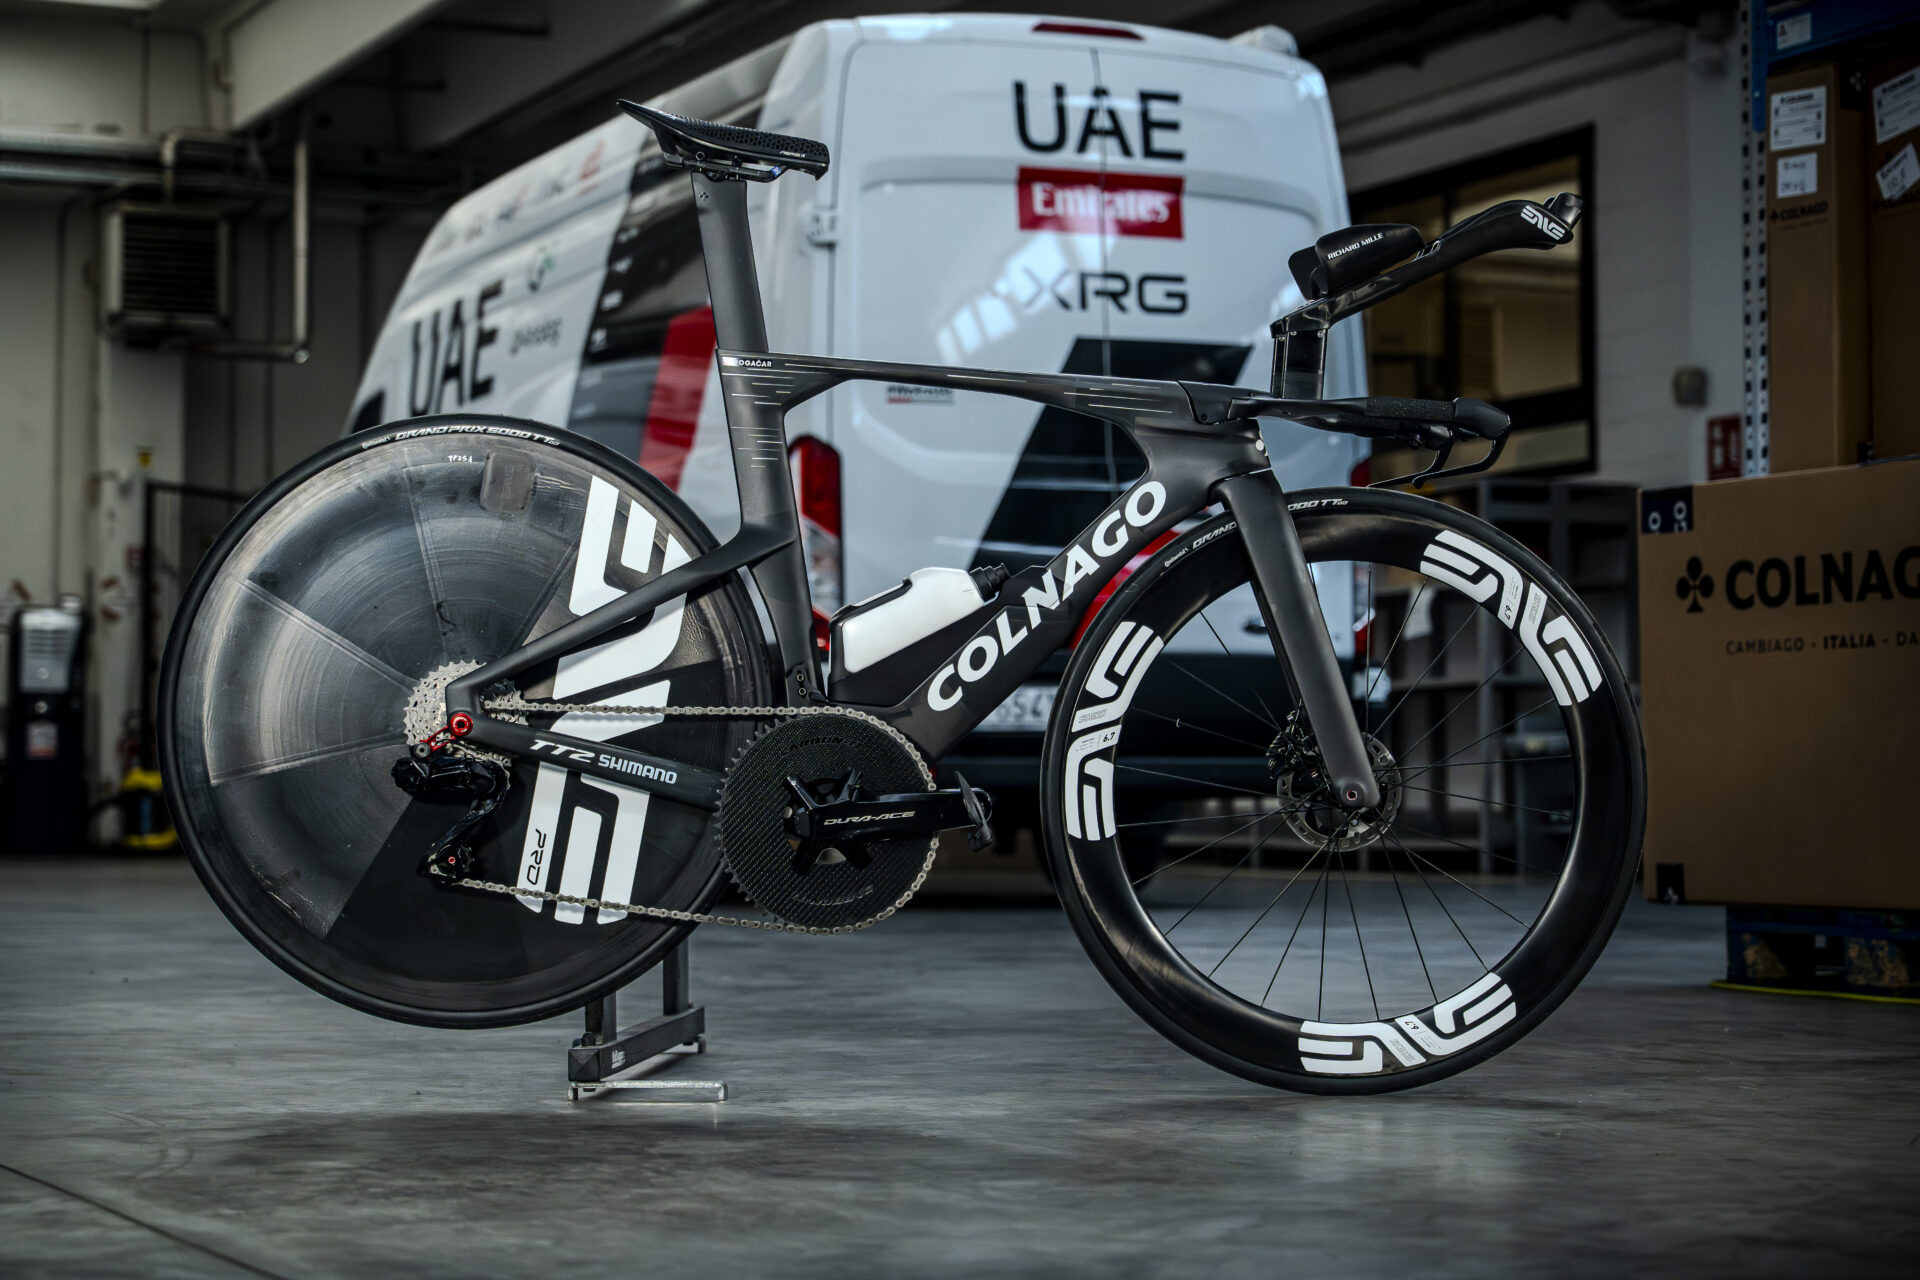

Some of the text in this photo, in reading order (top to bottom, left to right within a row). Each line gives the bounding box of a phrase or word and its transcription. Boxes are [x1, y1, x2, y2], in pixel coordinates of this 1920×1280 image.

[1013, 80, 1186, 161] UAE
[1031, 180, 1171, 225] Emirates
[1327, 232, 1384, 261] RICHARD MILLE
[408, 279, 504, 416] UAE
[394, 426, 450, 441] GRAND
[449, 424, 489, 433] PRIX
[927, 480, 1167, 712] COLNAGO
[1725, 637, 1804, 656] CAMBIAGO
[1823, 633, 1876, 650] ITALIA
[1102, 731, 1116, 743] 6.7
[598, 755, 678, 785] SHIMANO
[824, 810, 916, 827] DURA-ACE
[526, 828, 547, 886] PRO
